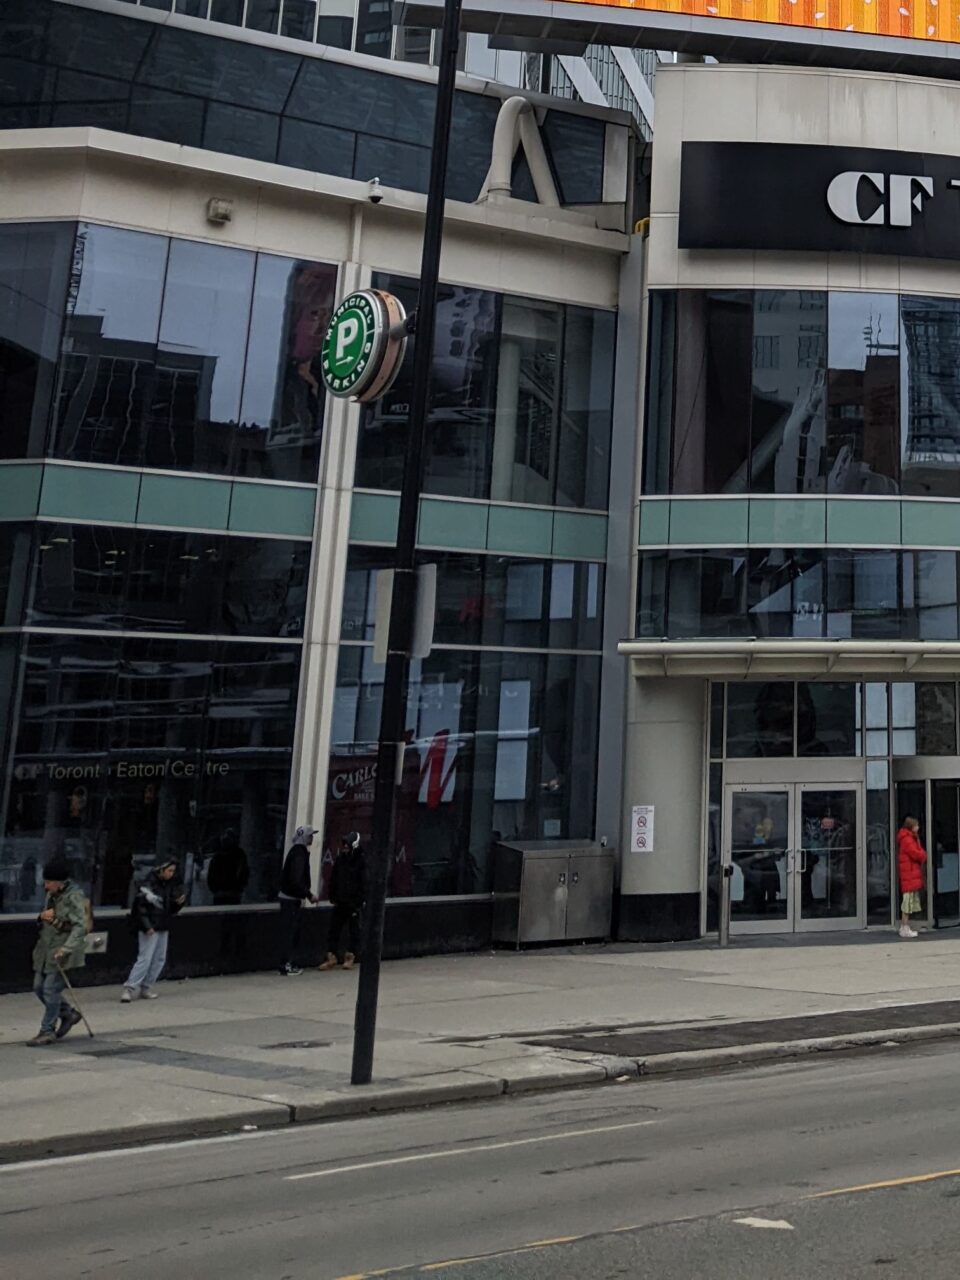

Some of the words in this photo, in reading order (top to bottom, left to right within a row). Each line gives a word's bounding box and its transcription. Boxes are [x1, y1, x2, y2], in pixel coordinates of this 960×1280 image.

[826, 171, 934, 227] CF
[325, 298, 373, 340] MUNICIPAL
[336, 318, 358, 360] P
[323, 342, 371, 389] PARKING
[47, 763, 113, 780] Toront
[117, 761, 166, 778] Eaton
[171, 760, 230, 776] Cetre
